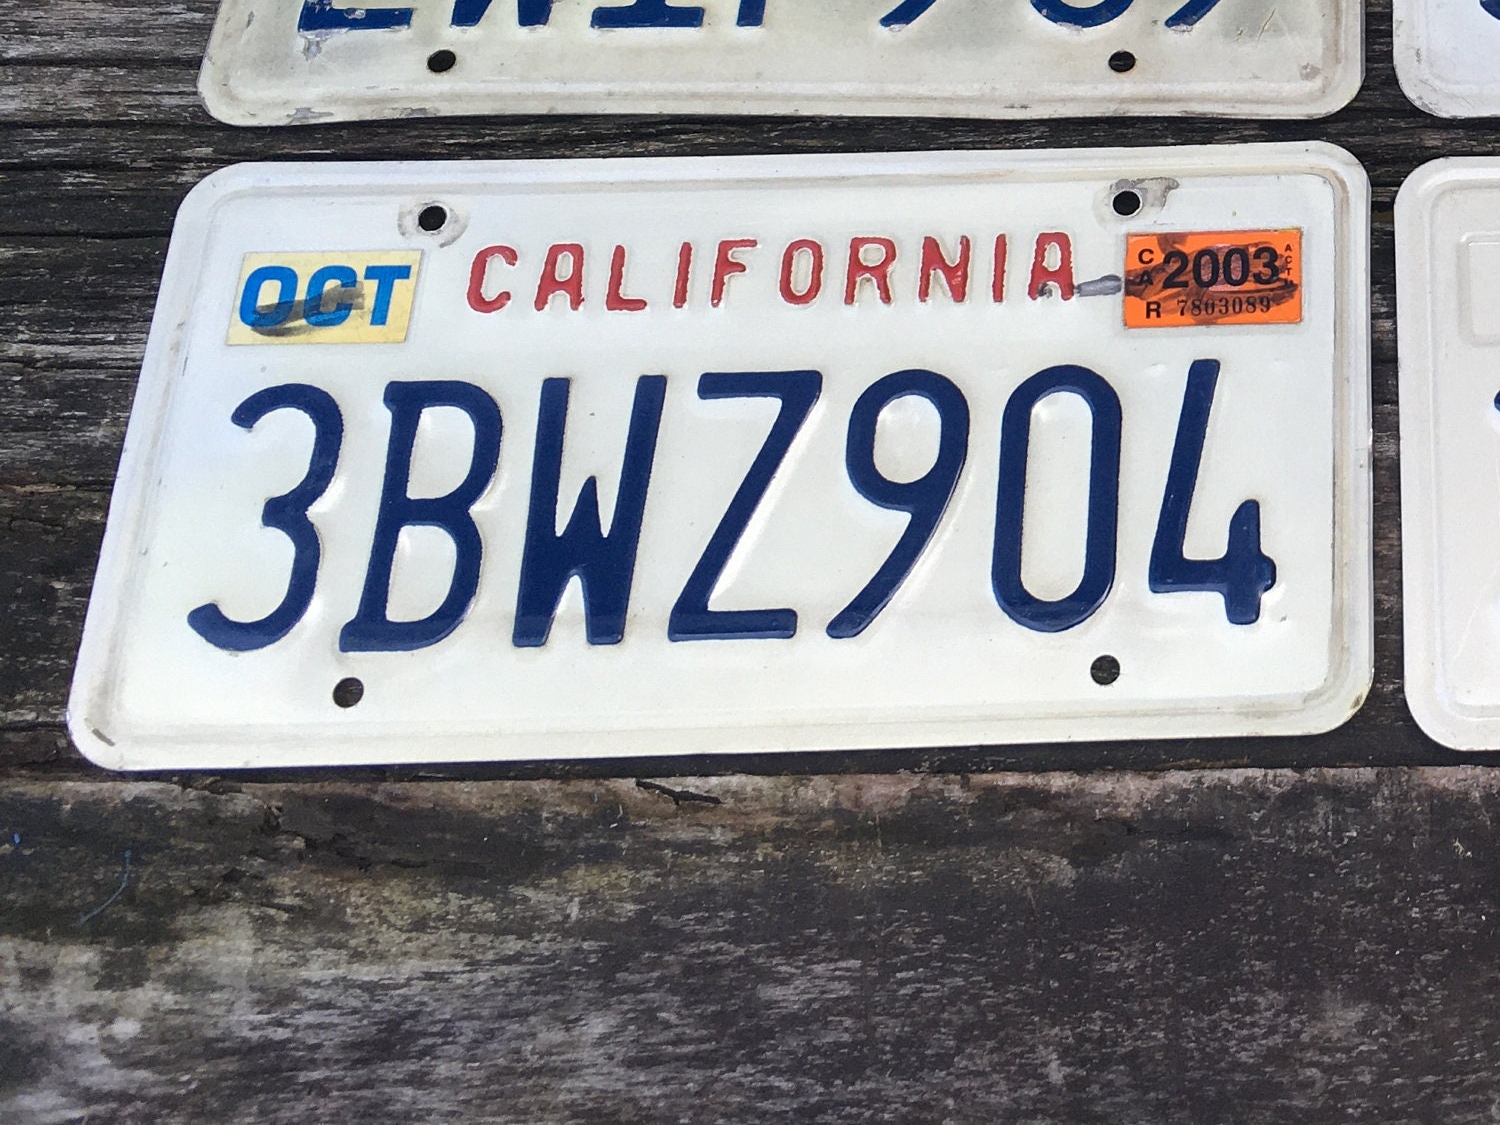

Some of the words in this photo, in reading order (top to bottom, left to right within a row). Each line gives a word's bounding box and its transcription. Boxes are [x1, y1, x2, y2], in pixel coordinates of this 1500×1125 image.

[238, 264, 412, 328] OCT
[466, 231, 1077, 315] CALIFORNIA
[1162, 245, 1281, 290] 2003
[1176, 295, 1272, 317] 7803089
[186, 358, 1278, 653] 3BWZ904
